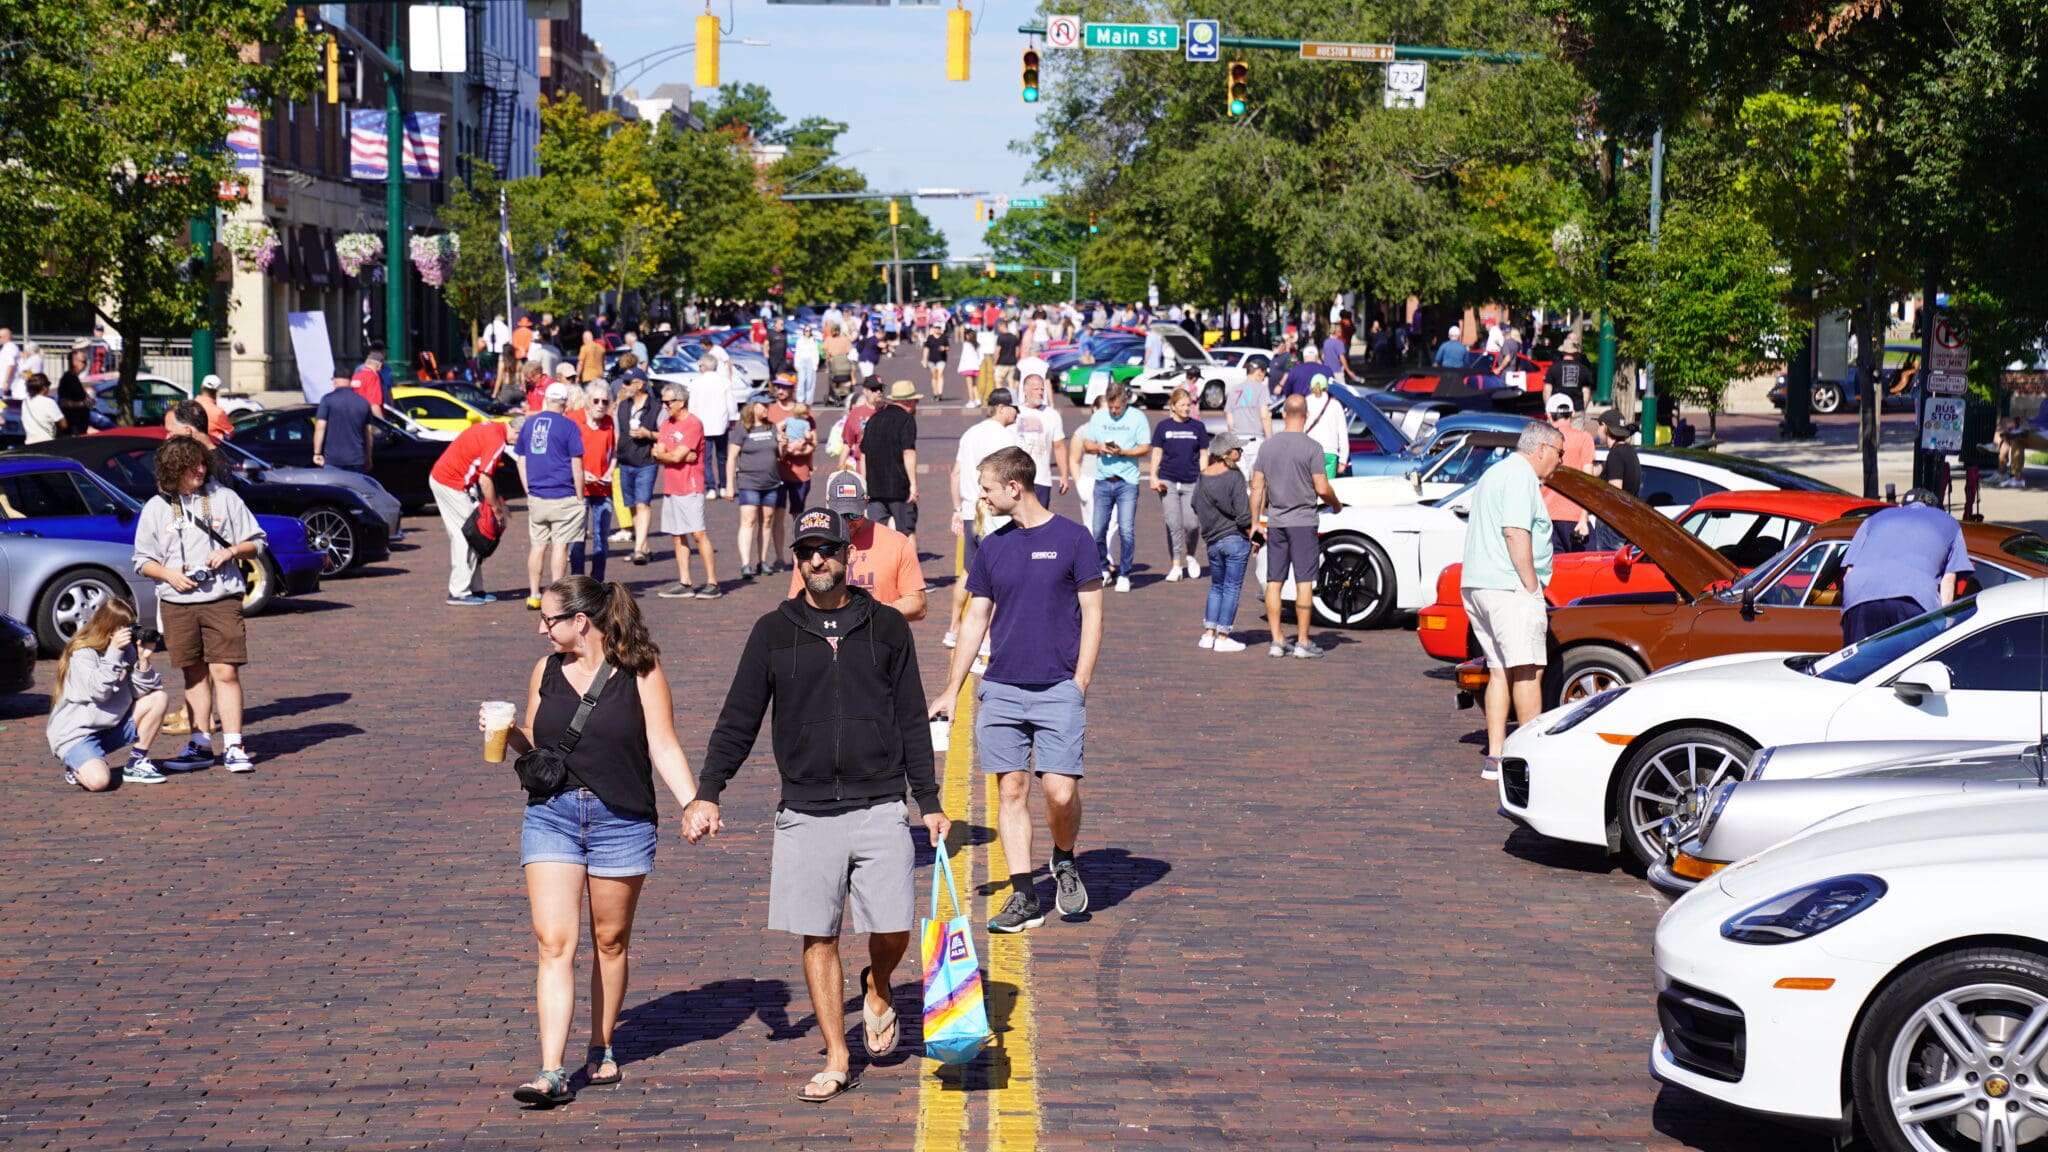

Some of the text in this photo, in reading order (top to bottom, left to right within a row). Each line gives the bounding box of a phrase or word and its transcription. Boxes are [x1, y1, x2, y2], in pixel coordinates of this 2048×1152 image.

[1097, 28, 1167, 45] Main St
[1391, 71, 1420, 85] 732
[1935, 404, 1956, 413] BUS
[1931, 412, 1958, 421] STOP
[950, 947, 967, 957] ALDI
